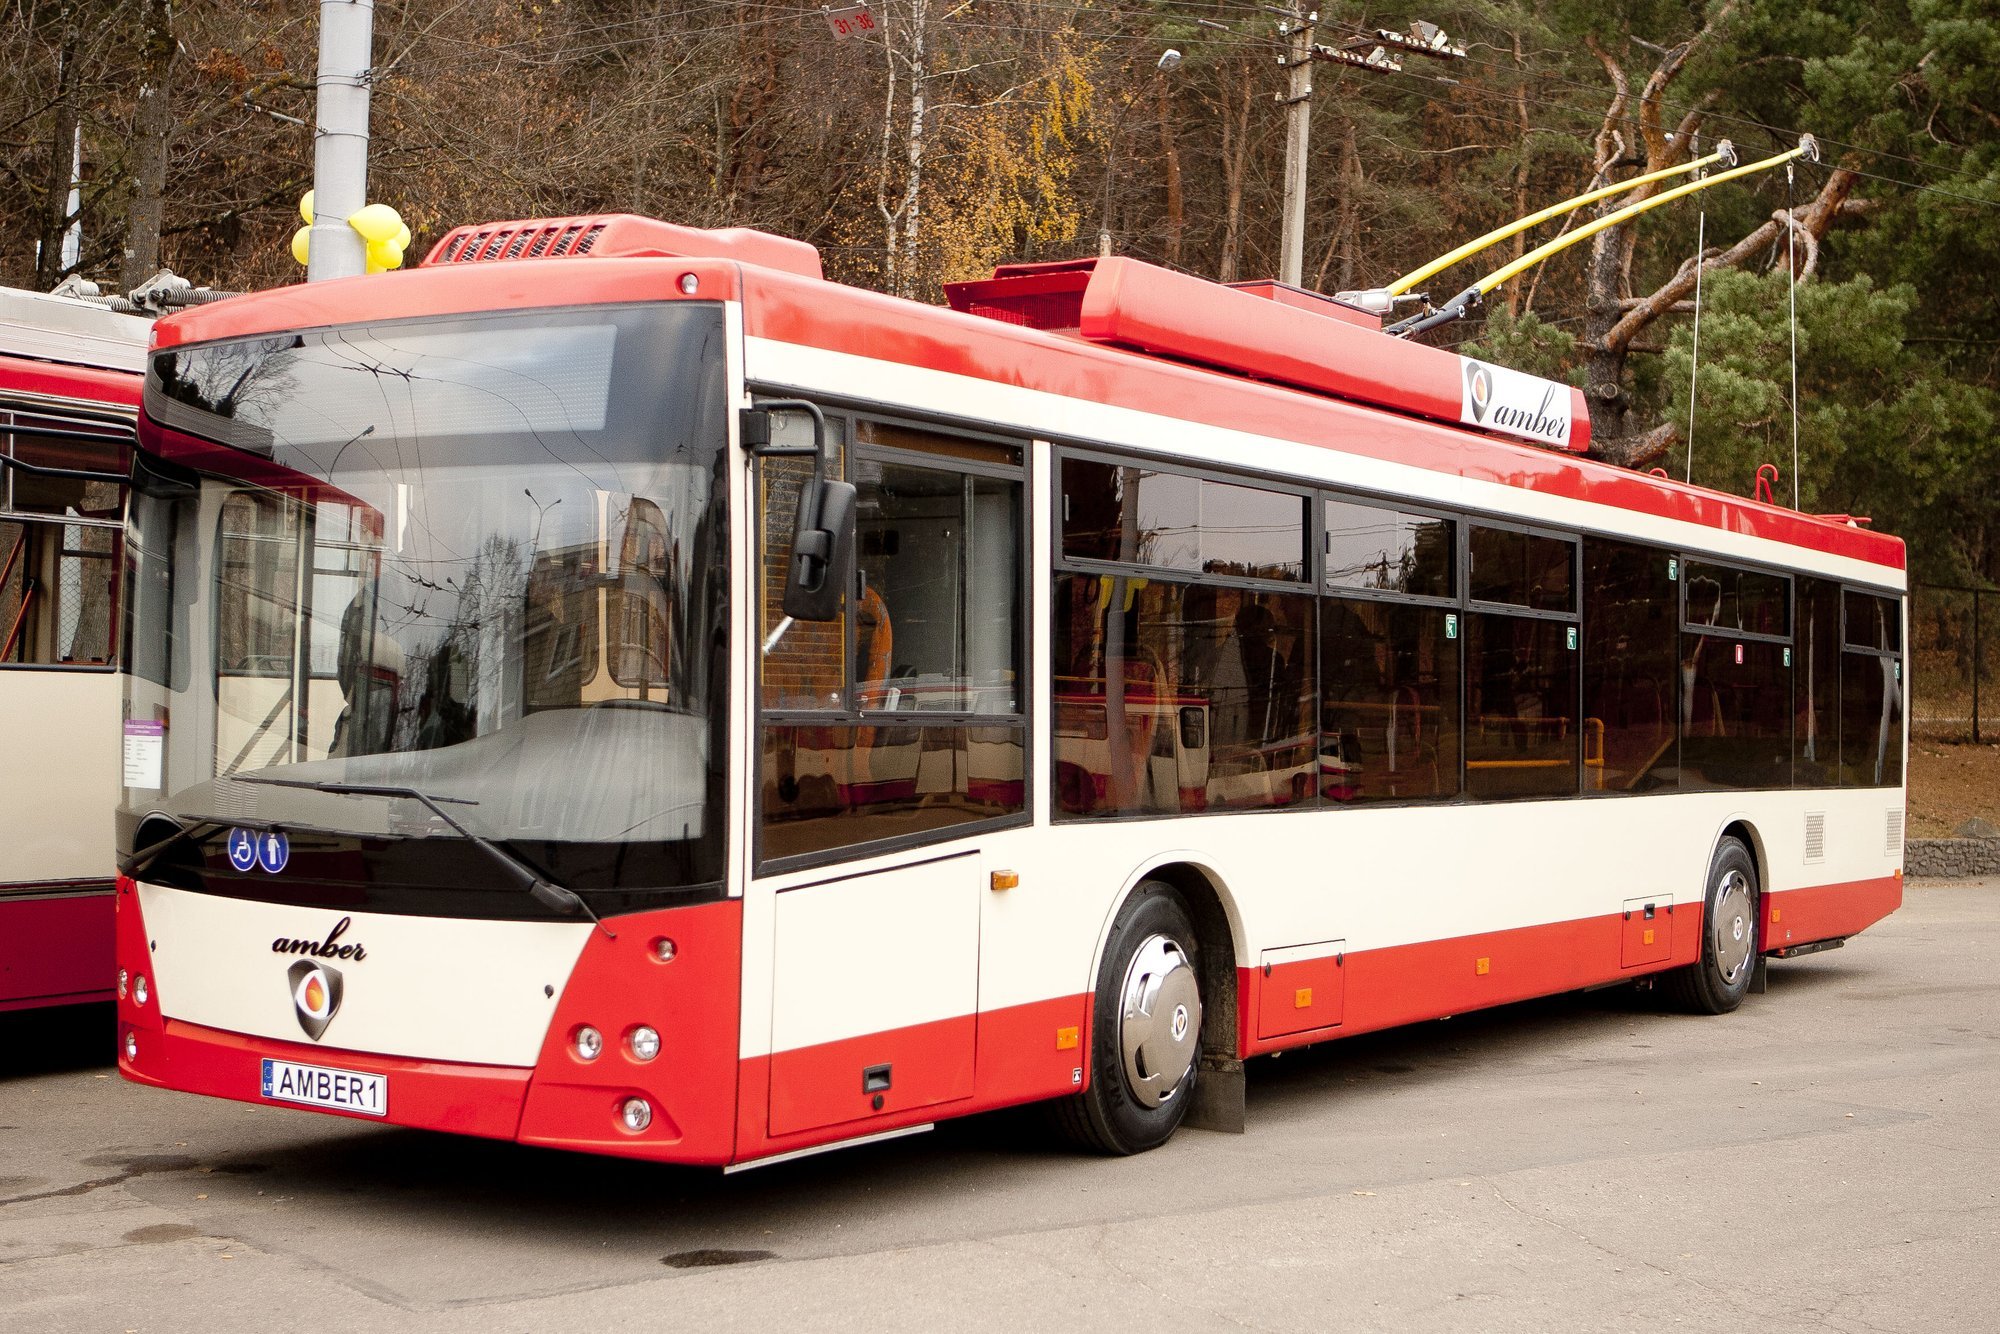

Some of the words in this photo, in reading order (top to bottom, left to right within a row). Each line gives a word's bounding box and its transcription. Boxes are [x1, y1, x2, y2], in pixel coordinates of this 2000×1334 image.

[1494, 383, 1567, 438] amber
[272, 916, 367, 961] amber
[263, 1083, 273, 1091] LT
[279, 1067, 377, 1108] AMBER1
